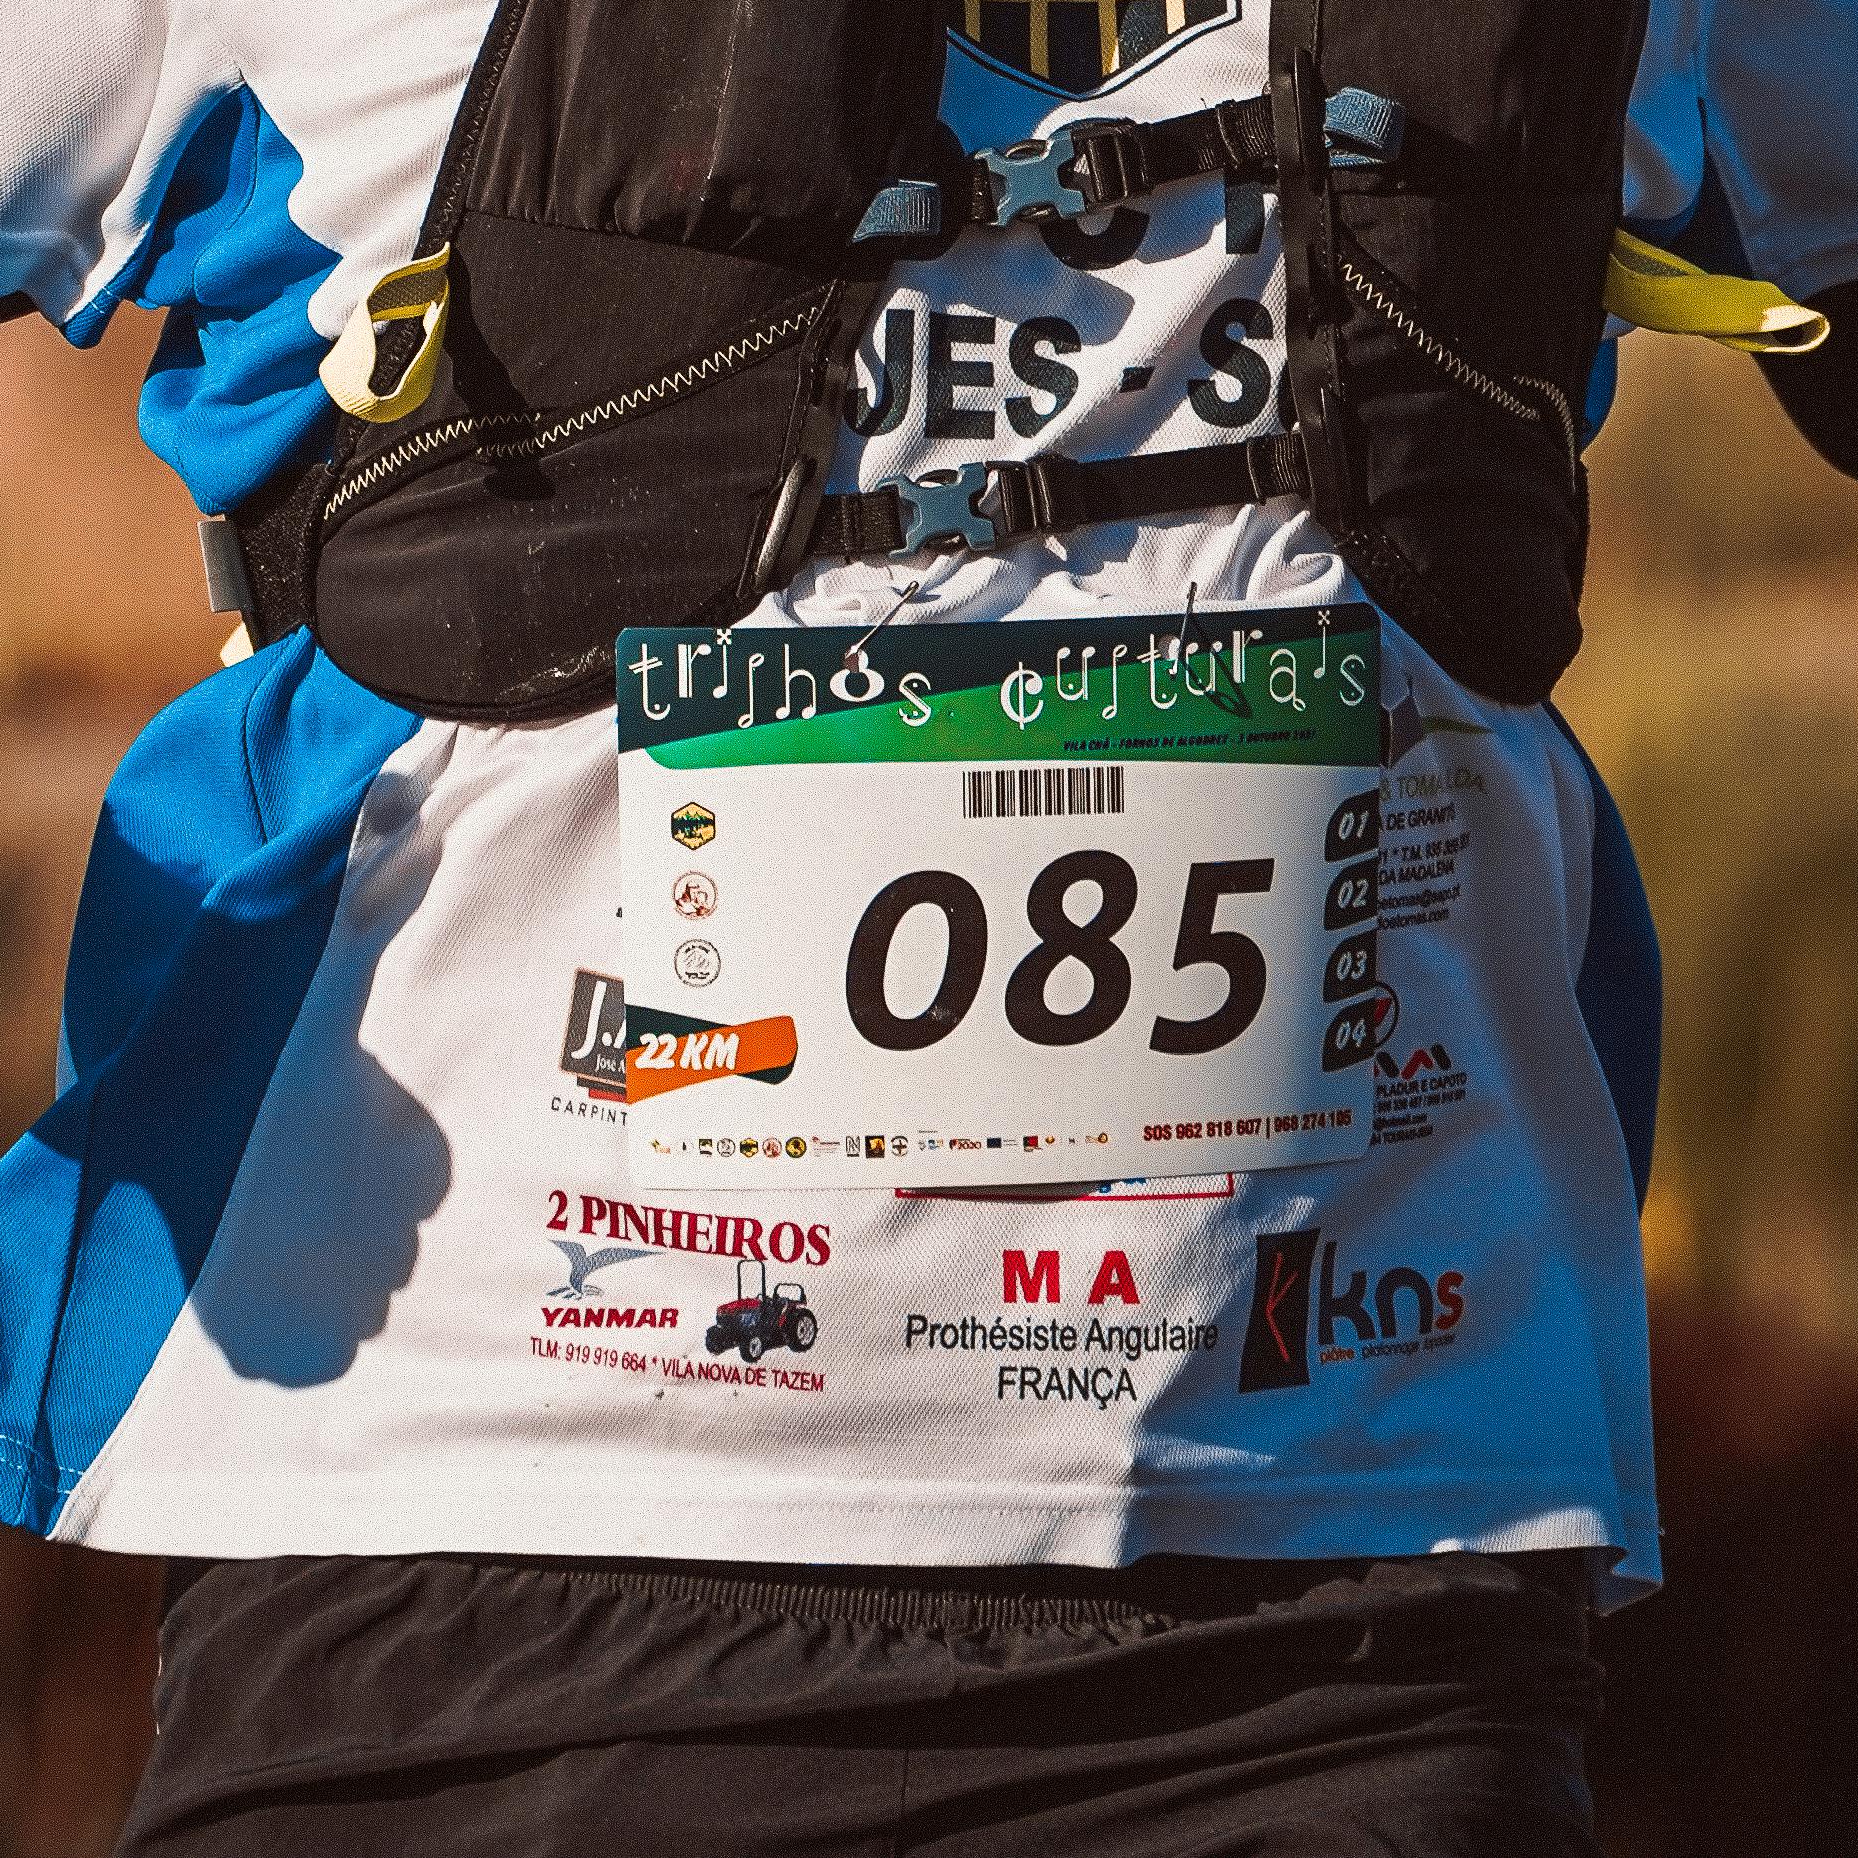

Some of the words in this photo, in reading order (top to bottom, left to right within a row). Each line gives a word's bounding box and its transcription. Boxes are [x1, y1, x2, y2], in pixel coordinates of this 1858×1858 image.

[1188, 298, 1288, 429] S
[1338, 811, 1370, 841] 01
[1386, 813, 1405, 831] DE
[1337, 879, 1370, 909] 02
[845, 849, 1275, 1056] 085
[1336, 950, 1368, 982] 03
[634, 1033, 677, 1070] 22
[679, 1033, 740, 1071] KM
[1335, 1018, 1367, 1050] 04
[1143, 1123, 1172, 1141] SOS
[1175, 1122, 1203, 1140] 962
[1206, 1120, 1232, 1138] 818
[1236, 1118, 1262, 1135] 607
[546, 1190, 569, 1231] 2
[579, 1194, 831, 1266] PINHEIROS
[1002, 1249, 1060, 1304] M
[1088, 1250, 1140, 1305] A
[1317, 1241, 1465, 1346] kns
[541, 1307, 680, 1329] YANMAR
[905, 1313, 1077, 1352] Prothésiste
[1085, 1316, 1219, 1361] Angulaire
[530, 1336, 562, 1360] TLM:
[565, 1342, 590, 1364] 919
[593, 1346, 618, 1369] 919
[621, 1350, 647, 1373] 664
[661, 1358, 696, 1381] VILA
[697, 1362, 742, 1386] NOVA
[744, 1366, 767, 1388] DE
[772, 1370, 827, 1392] TAZEM
[997, 1365, 1137, 1410] FRANÇA
